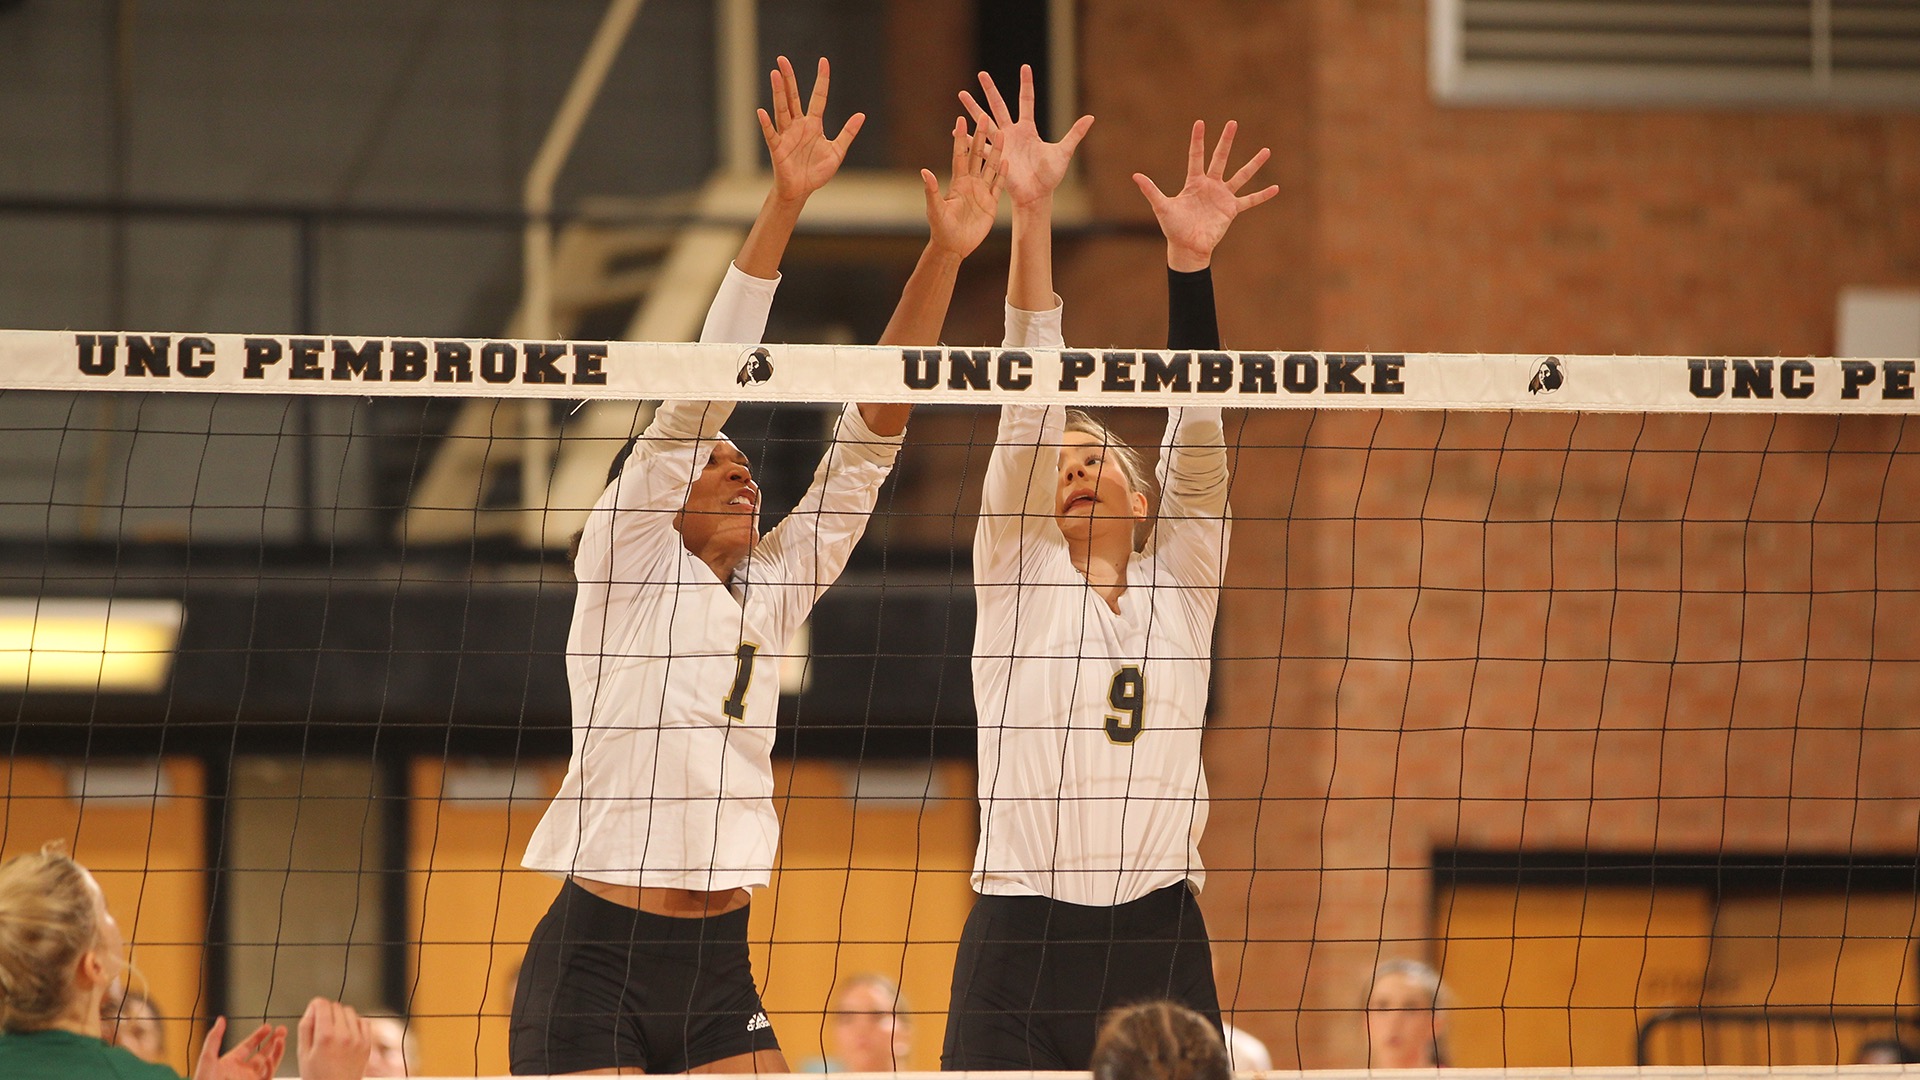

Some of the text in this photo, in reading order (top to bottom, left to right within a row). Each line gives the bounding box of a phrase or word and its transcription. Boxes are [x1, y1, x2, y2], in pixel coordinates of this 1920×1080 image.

[75, 333, 609, 386] UNC PEMBROKE
[901, 349, 1406, 395] UNC PEMBROKE
[1687, 358, 1917, 401] UNC PE
[721, 640, 760, 724] 1
[1103, 664, 1147, 746] 9
